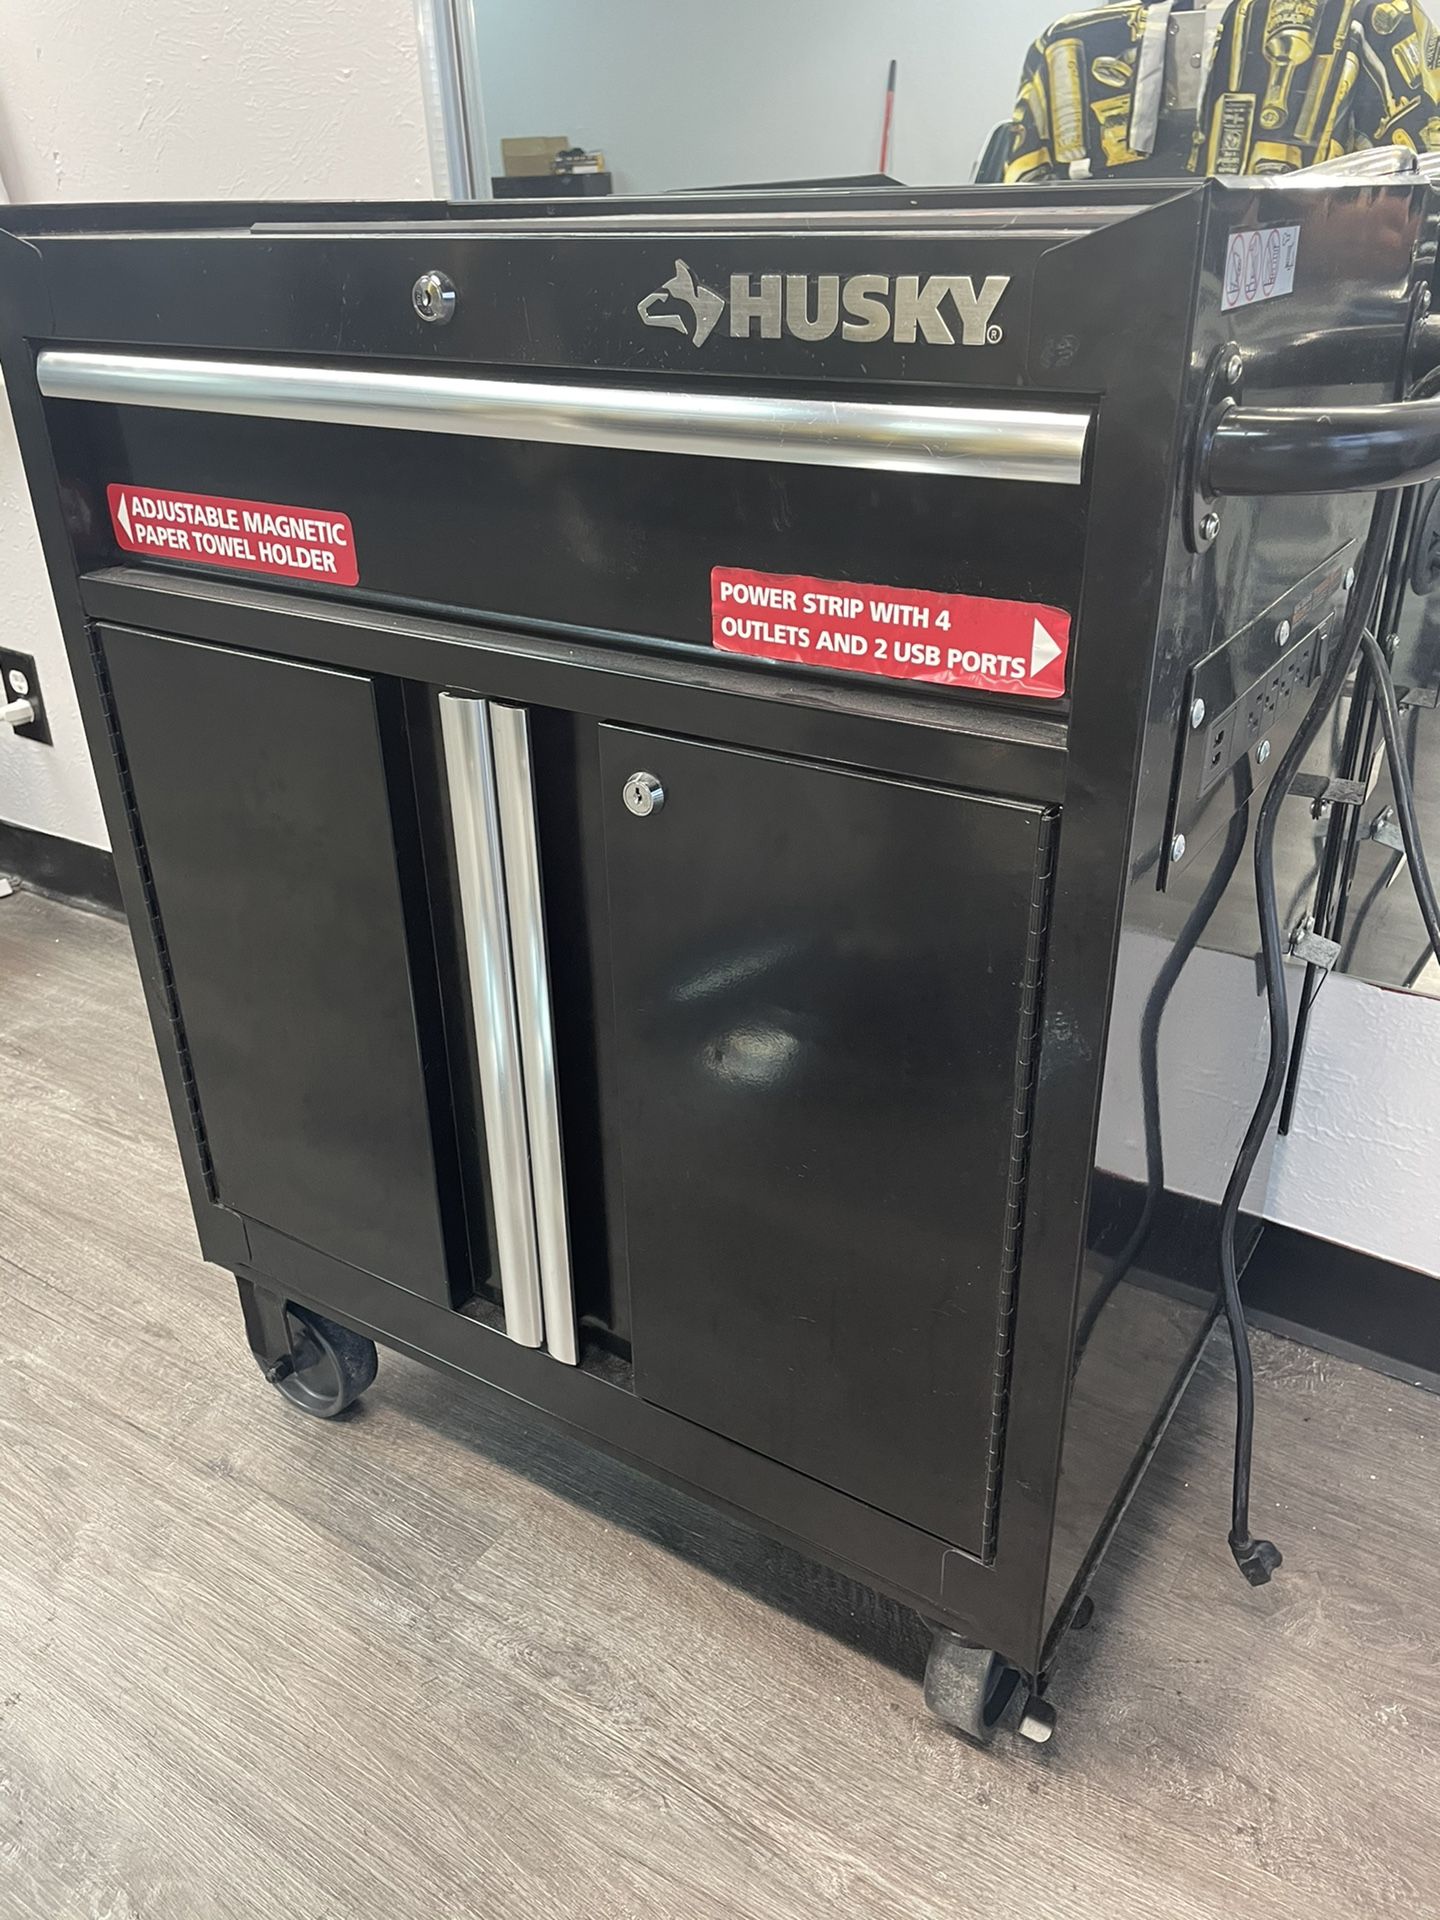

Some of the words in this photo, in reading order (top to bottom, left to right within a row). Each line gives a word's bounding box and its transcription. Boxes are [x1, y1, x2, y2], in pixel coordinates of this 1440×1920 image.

[131, 496, 240, 531] ADJUSTABLE
[242, 511, 347, 546] MAGNETIC
[134, 523, 191, 550] PAPER
[192, 531, 256, 560] TOWEL
[258, 541, 337, 573] HOLDER
[720, 581, 797, 611] POWER
[802, 592, 864, 619] STRIP
[870, 604, 929, 629] WITH
[935, 610, 951, 631] 4
[721, 616, 810, 648] OUTLETS
[816, 631, 868, 656] AND
[874, 639, 888, 659] 2
[893, 641, 941, 667] USB
[947, 648, 1026, 679] PORTS
